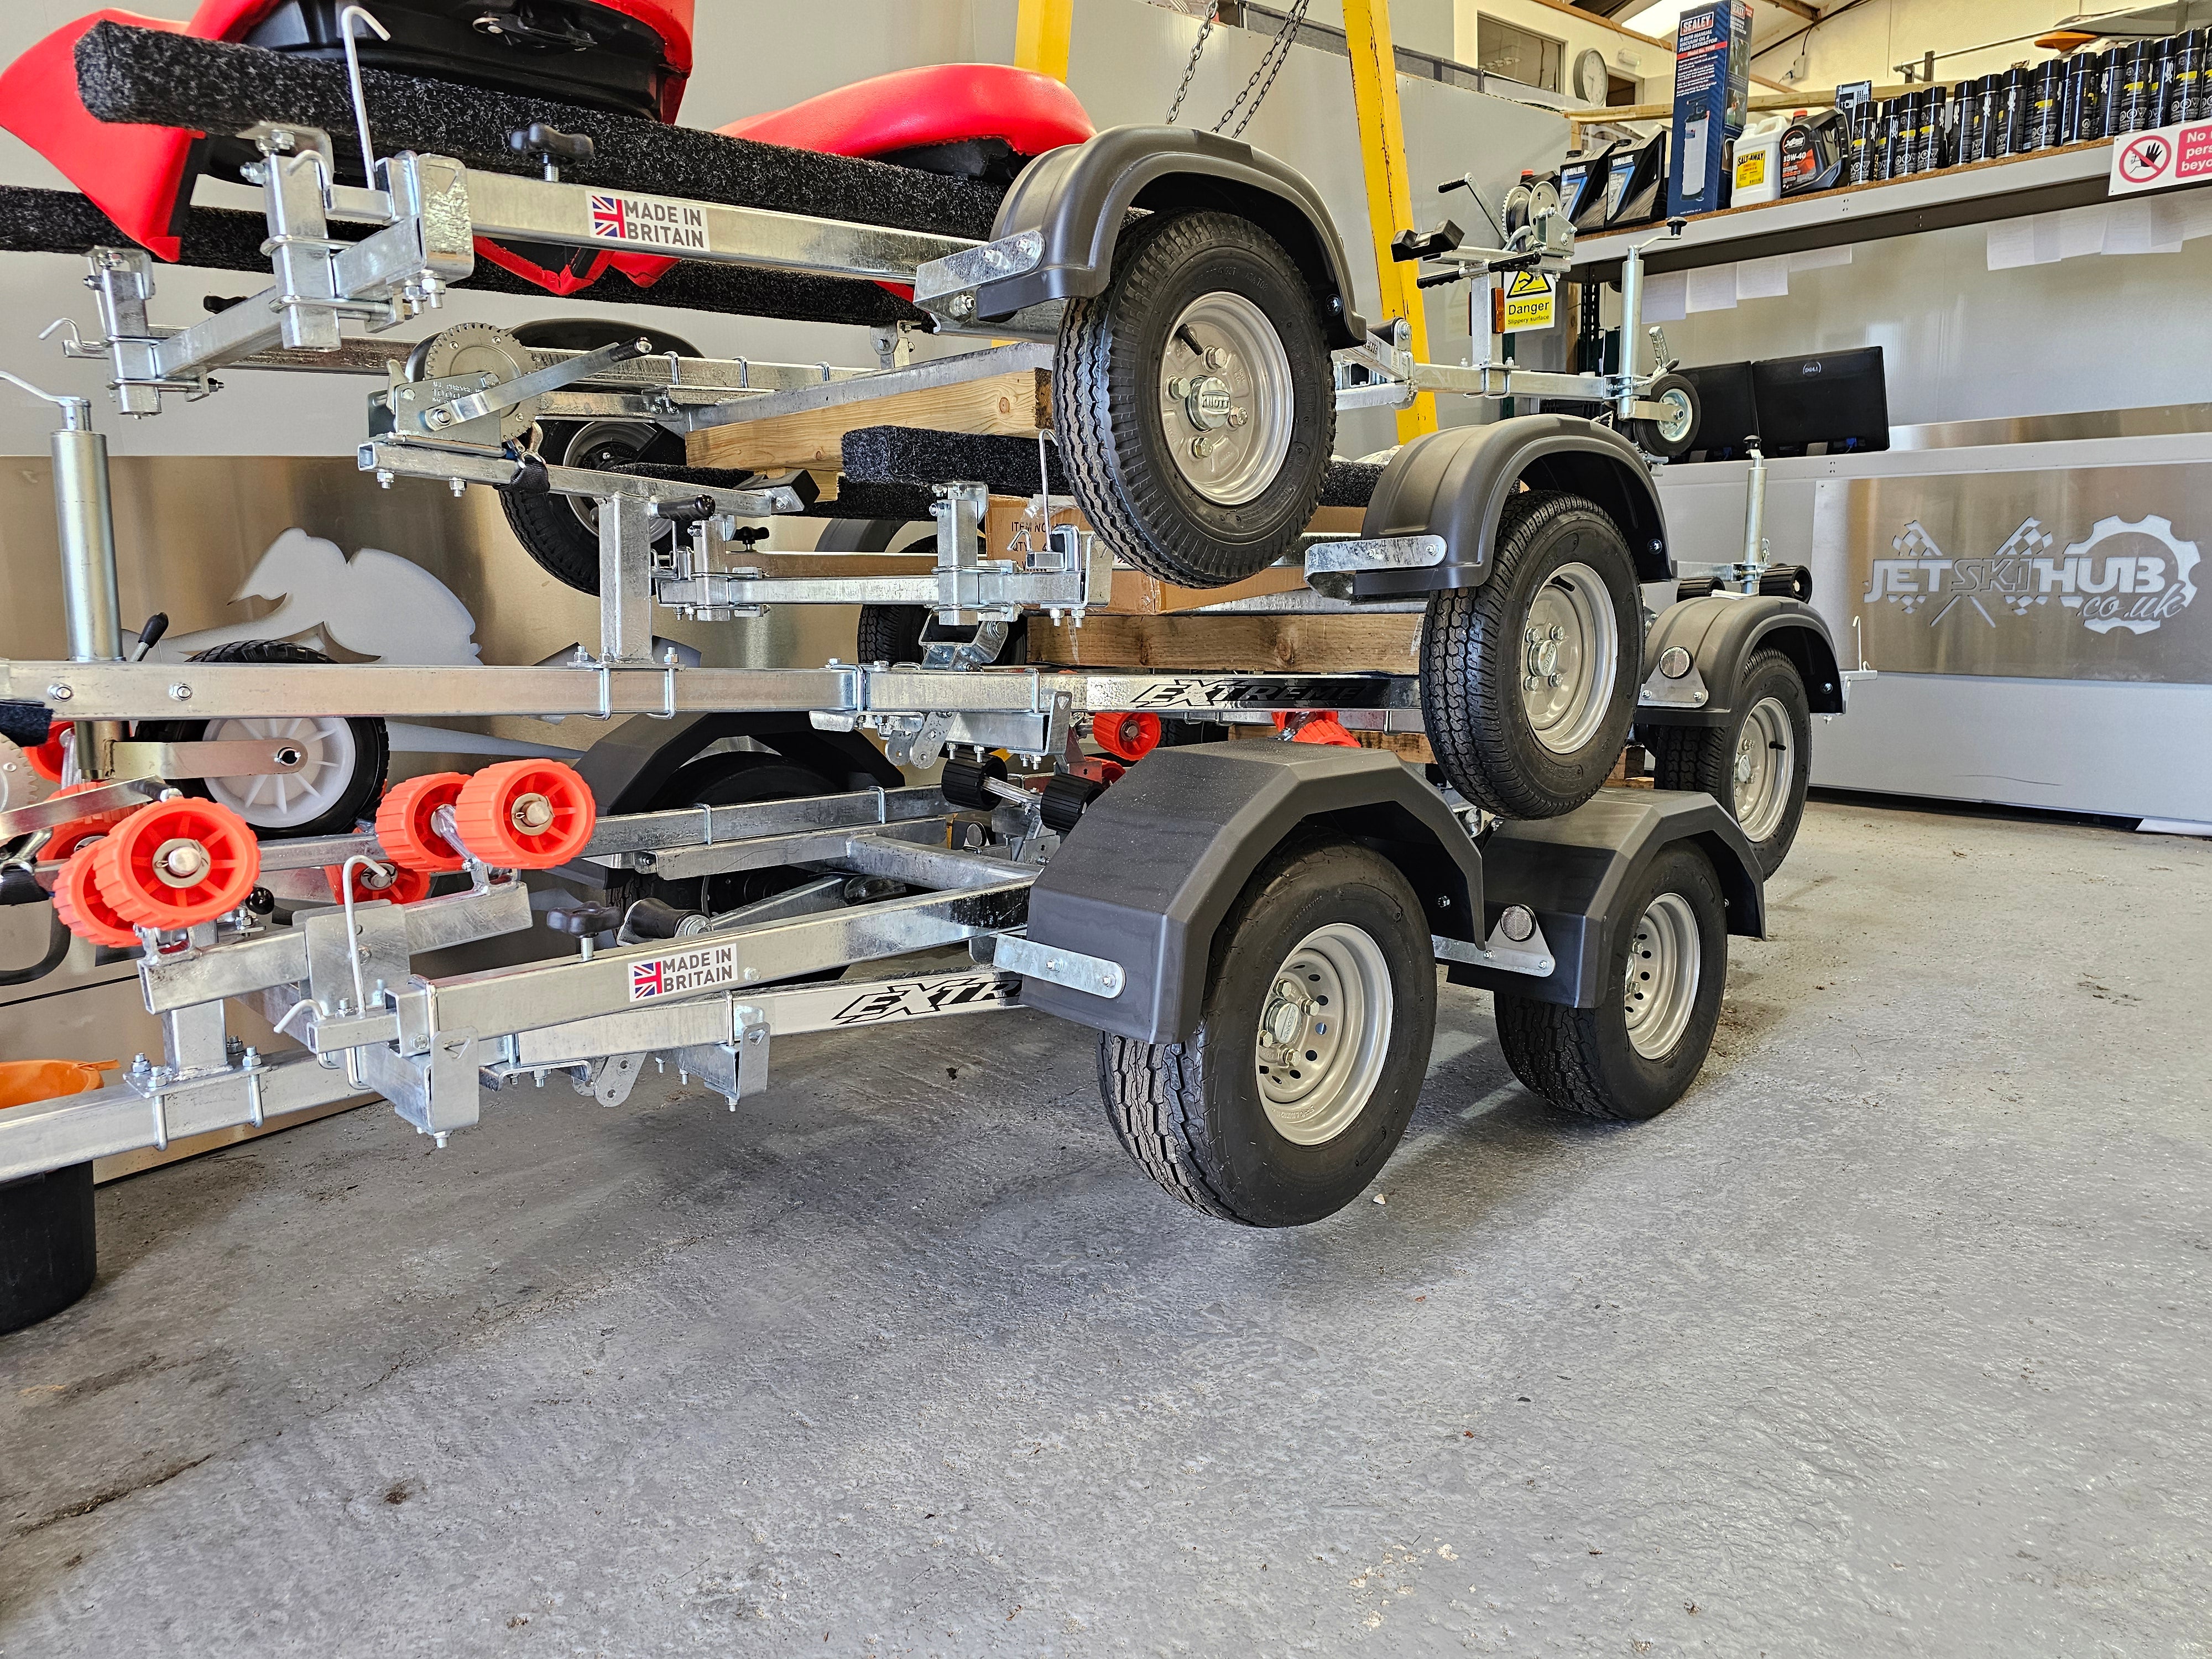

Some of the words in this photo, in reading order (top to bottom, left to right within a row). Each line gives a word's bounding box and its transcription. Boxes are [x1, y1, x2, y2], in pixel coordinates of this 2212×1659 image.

[1683, 14, 1711, 33] SEALEY
[1694, 29, 1713, 39] MANUAL
[1680, 37, 1698, 48] VACUUM
[1692, 37, 1718, 49] EXTRACTOR
[2187, 131, 2206, 143] No
[1612, 154, 1634, 166] YAMALUBE
[1738, 152, 1764, 166] SALT-AWAY
[1787, 152, 1807, 162] 5W-40
[1564, 165, 1587, 176] YAMALUBE
[624, 200, 679, 223] MADE
[683, 208, 702, 227] IN
[626, 221, 705, 248] BRITAIN
[1509, 301, 1550, 315] Danger
[432, 388, 460, 399] 1000
[1202, 395, 1230, 408] KNOTT
[1011, 521, 1032, 533] ITEM
[1130, 679, 1367, 708] EXTREME
[662, 951, 711, 974] MADE
[716, 947, 732, 964] IN
[664, 964, 732, 993] BRITAIN
[1282, 1006, 1296, 1041] KNOTT
